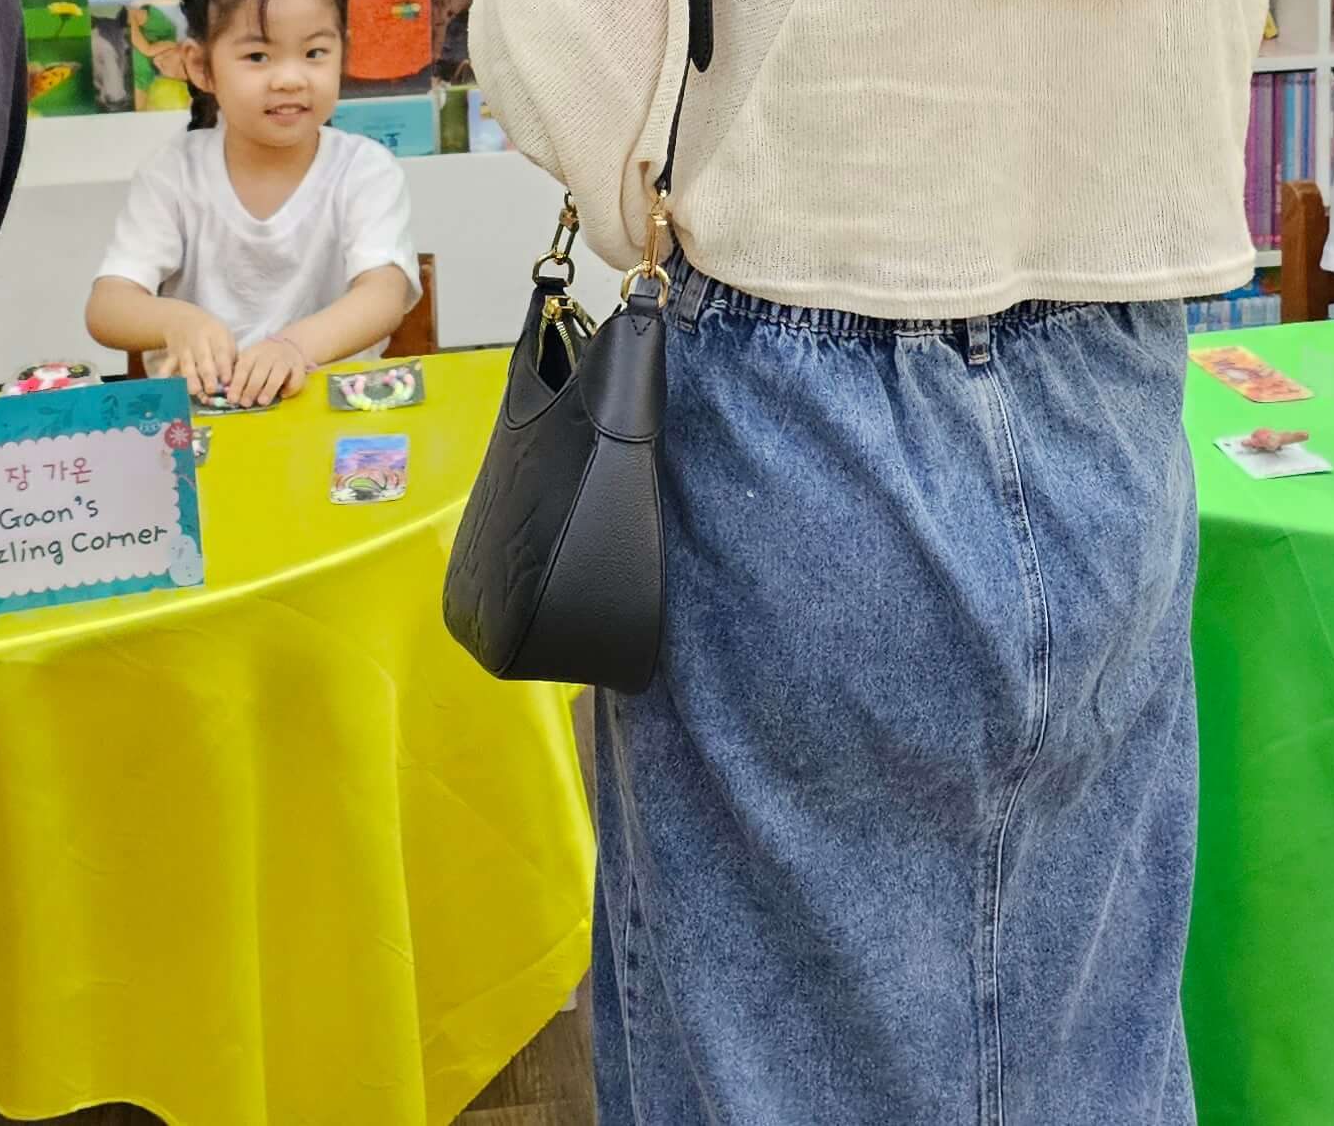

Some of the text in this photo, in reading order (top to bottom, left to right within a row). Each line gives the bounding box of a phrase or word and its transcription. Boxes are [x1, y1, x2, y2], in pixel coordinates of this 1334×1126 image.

[4, 456, 93, 491] 장 가온
[71, 525, 169, 554] Corner
